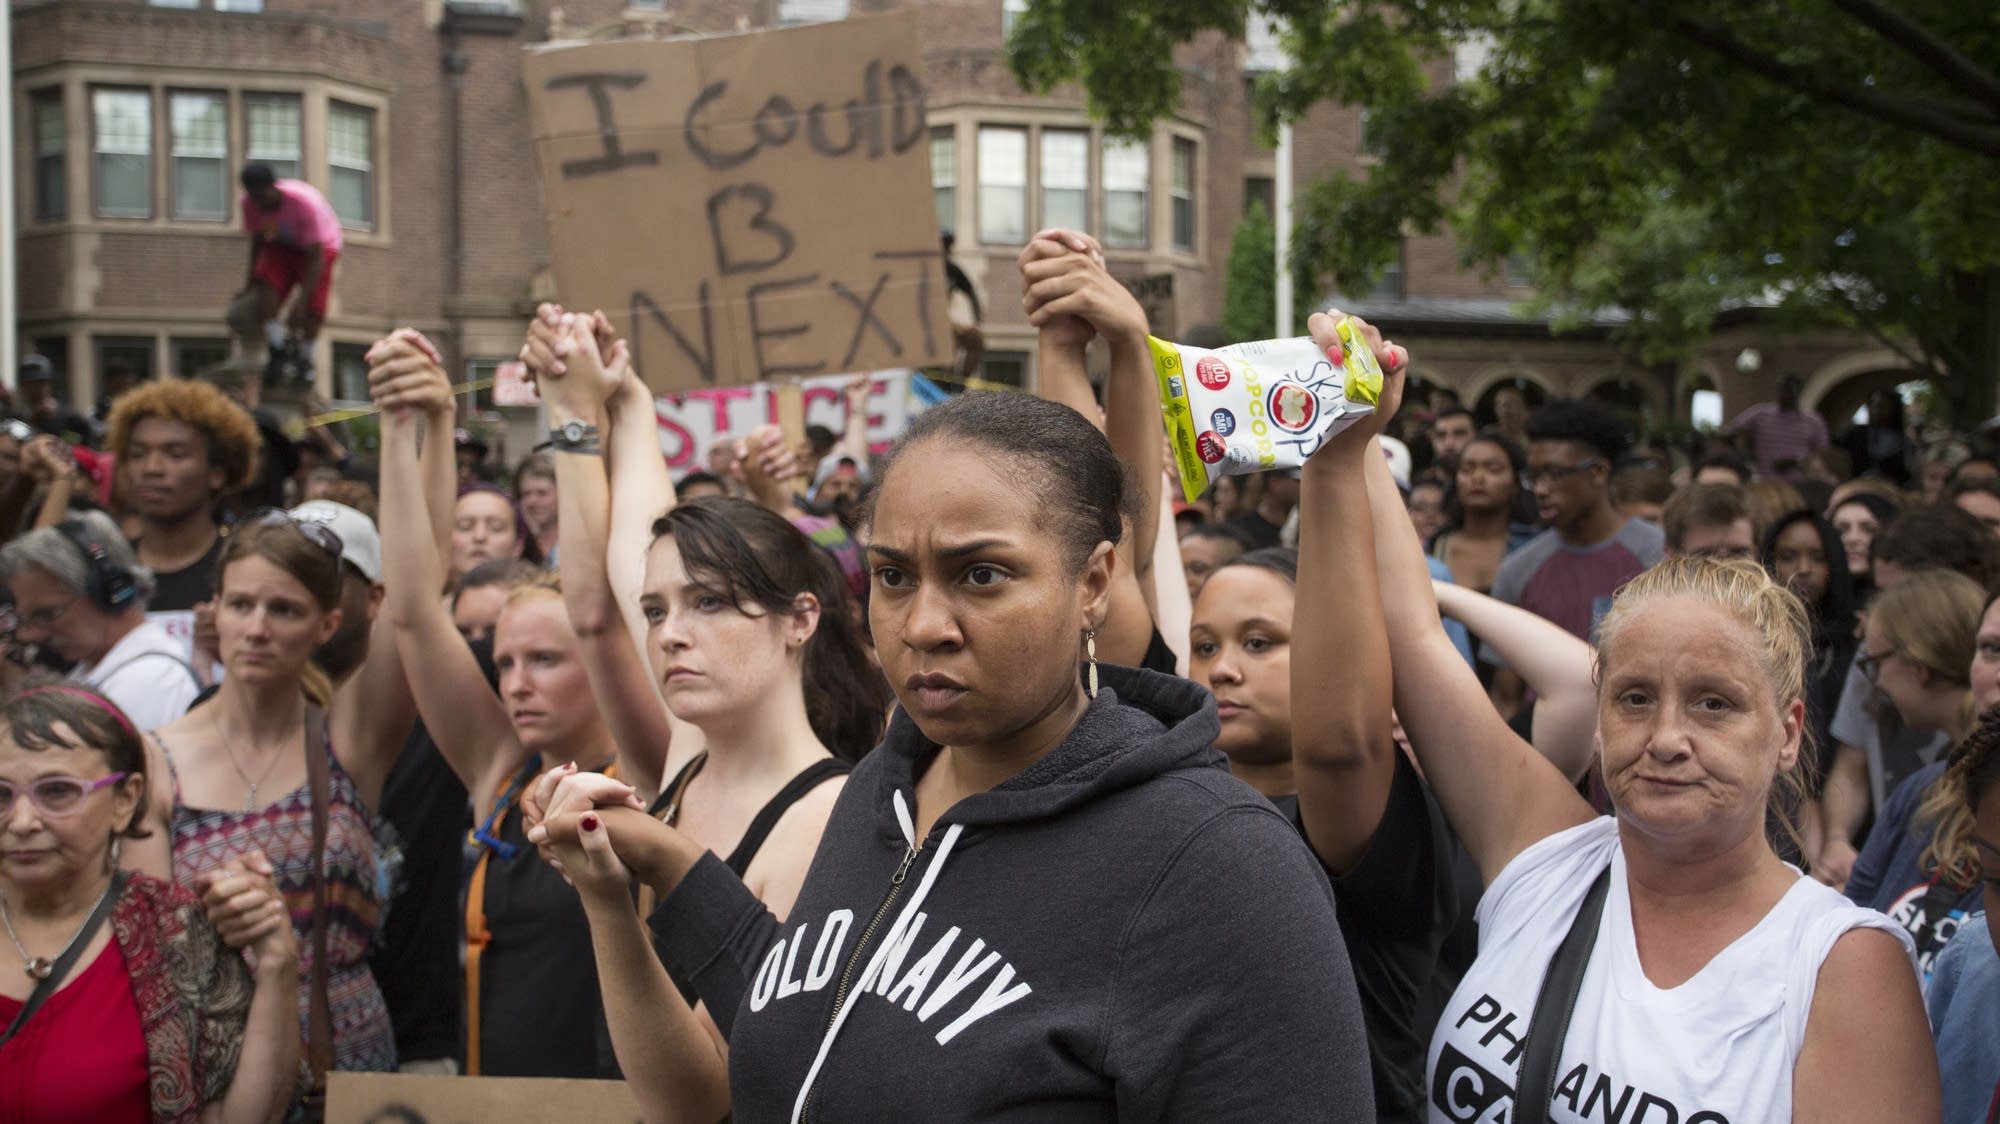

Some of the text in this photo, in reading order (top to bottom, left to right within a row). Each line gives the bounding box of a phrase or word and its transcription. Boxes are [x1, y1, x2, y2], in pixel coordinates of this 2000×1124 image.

[546, 72, 660, 180] I
[706, 182, 795, 276] B
[629, 250, 943, 383] NEXT
[1212, 363, 1228, 382] 100
[1214, 413, 1227, 432] GMO
[750, 909, 1032, 1046] OLD NAVY
[1455, 993, 1730, 1124] PHAND
